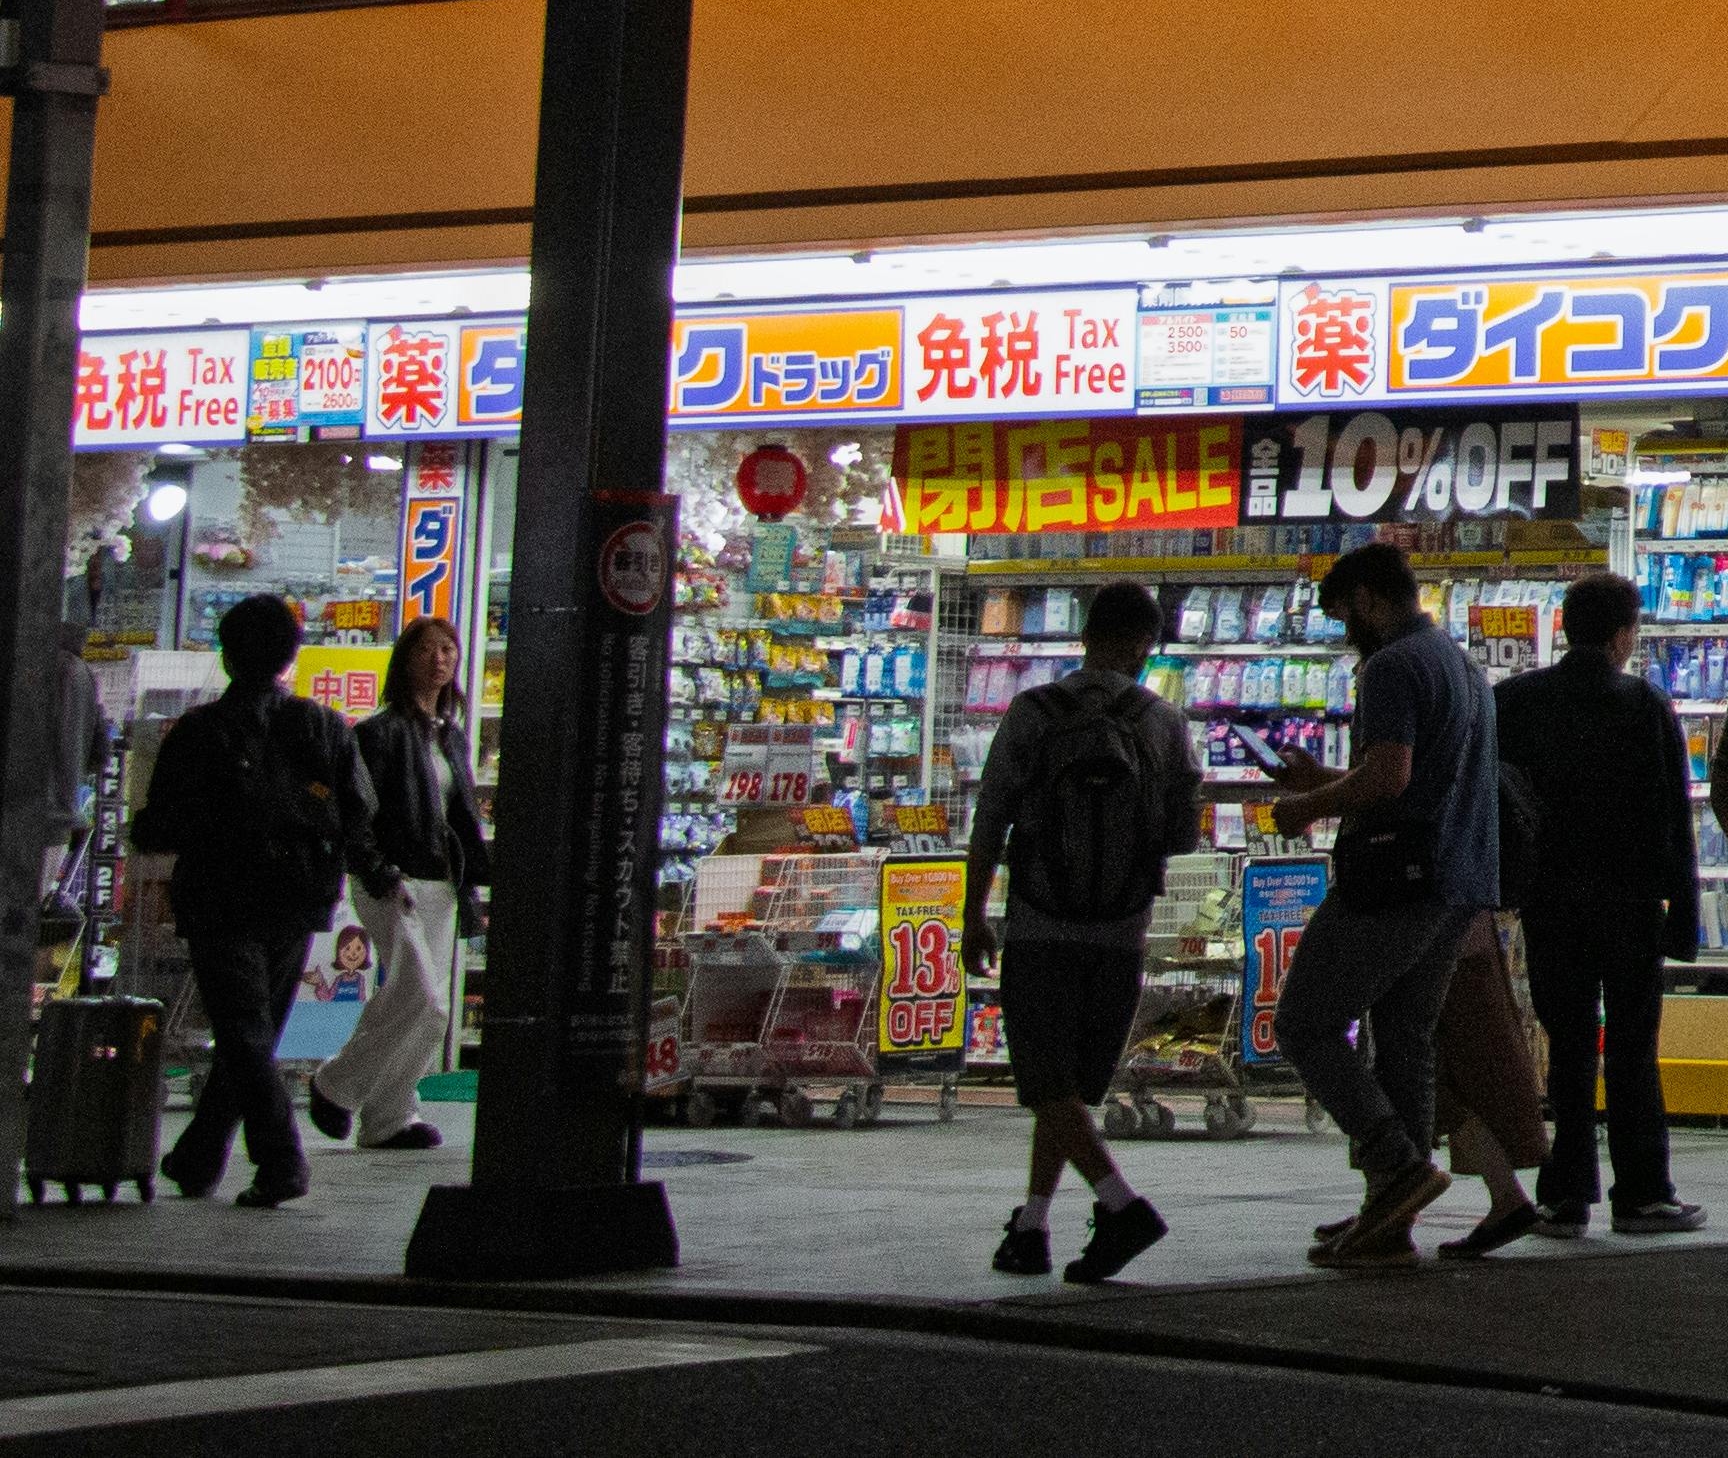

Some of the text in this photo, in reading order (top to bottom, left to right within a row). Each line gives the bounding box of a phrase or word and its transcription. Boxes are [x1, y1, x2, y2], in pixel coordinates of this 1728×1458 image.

[1296, 282, 1373, 397] 薬
[73, 348, 234, 432] 免税 Tax
[377, 307, 1119, 429] 薬 免税 Tax
[1054, 355, 1126, 395] Free
[179, 389, 238, 427] Free
[907, 421, 1232, 534] 閉店SALE
[1282, 411, 1574, 519] 10%OFF
[312, 670, 379, 708] 中国
[724, 769, 807, 801] 198 178
[895, 905, 941, 917] TAX-FREE
[890, 999, 955, 1043] OFF
